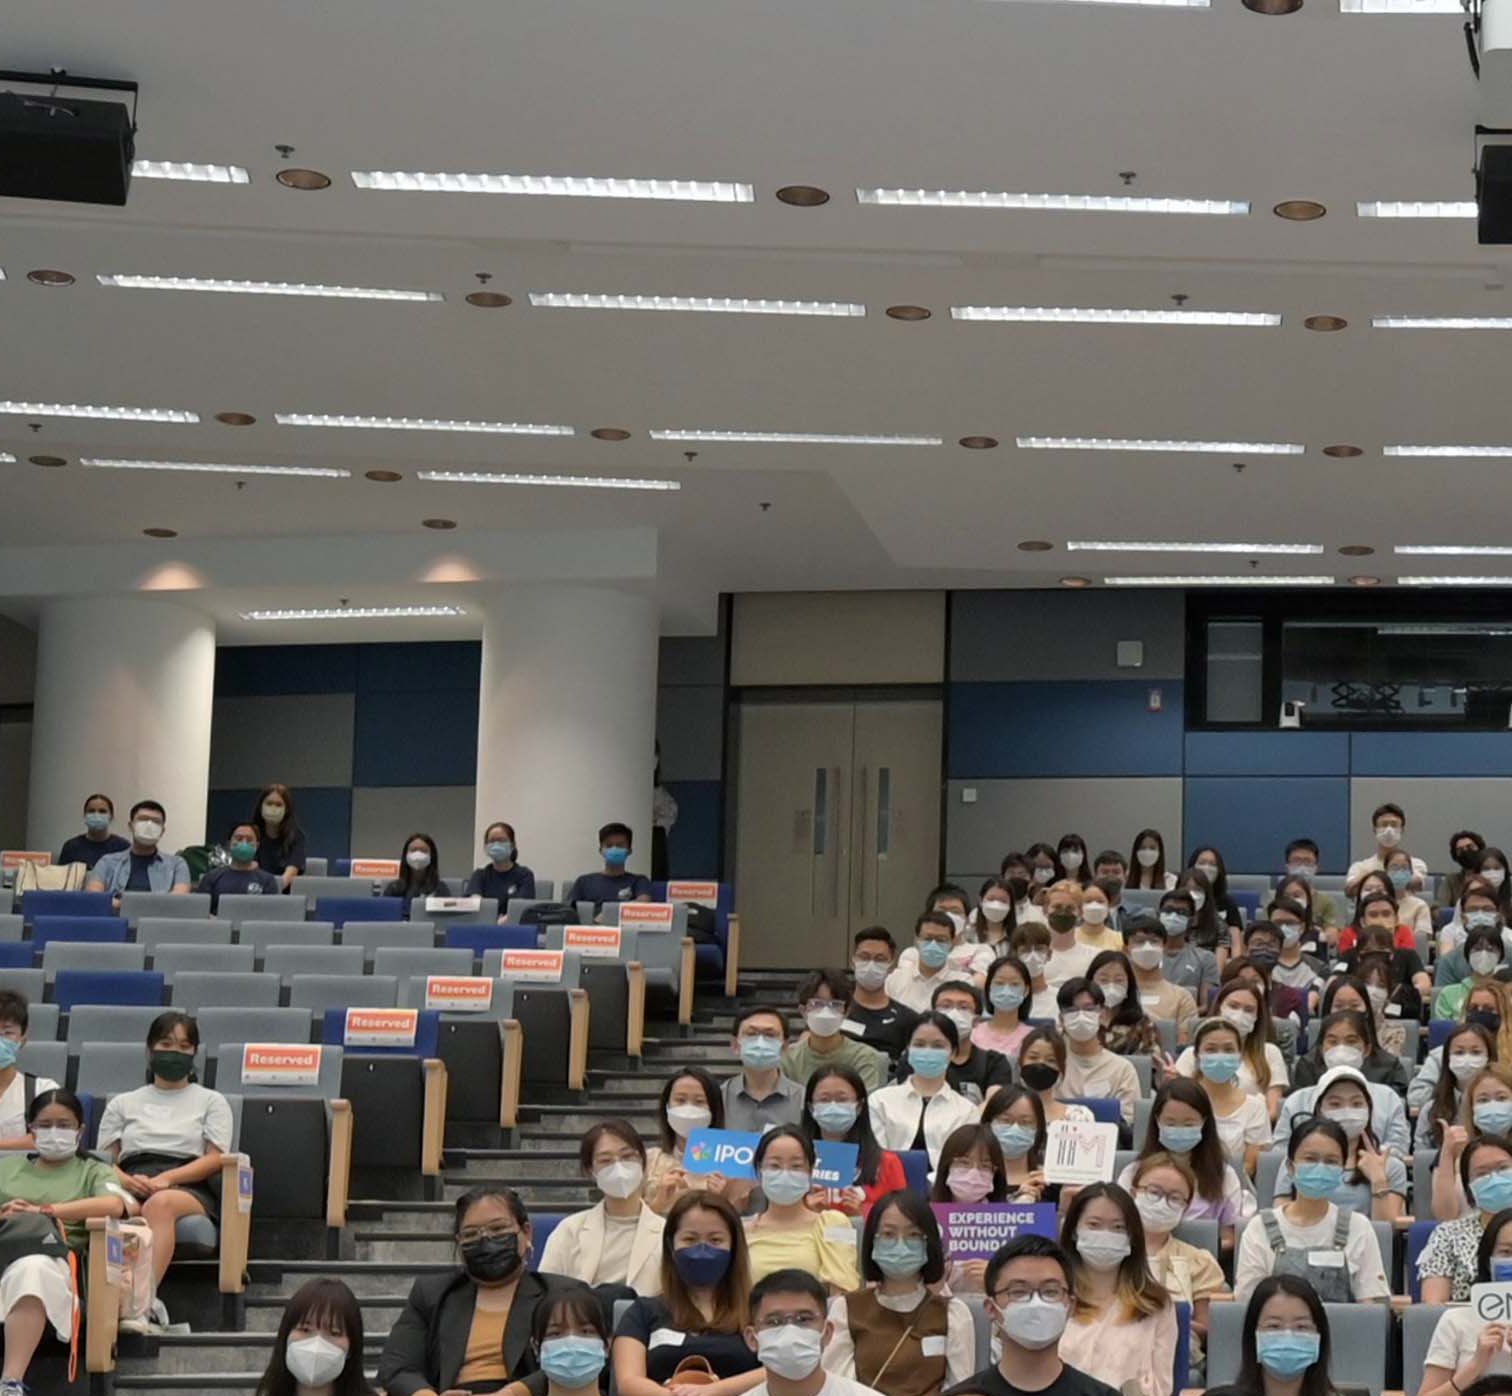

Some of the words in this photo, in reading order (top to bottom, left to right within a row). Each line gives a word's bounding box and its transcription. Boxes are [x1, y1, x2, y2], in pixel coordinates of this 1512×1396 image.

[505, 956, 558, 968] Reserved
[432, 983, 486, 996] Reserved
[352, 1016, 409, 1029] Reserved
[250, 1053, 313, 1067] Reserved
[714, 1144, 754, 1166] IPO
[949, 1212, 1035, 1225] EXPERIENCE
[949, 1226, 1017, 1239] WITHOUT
